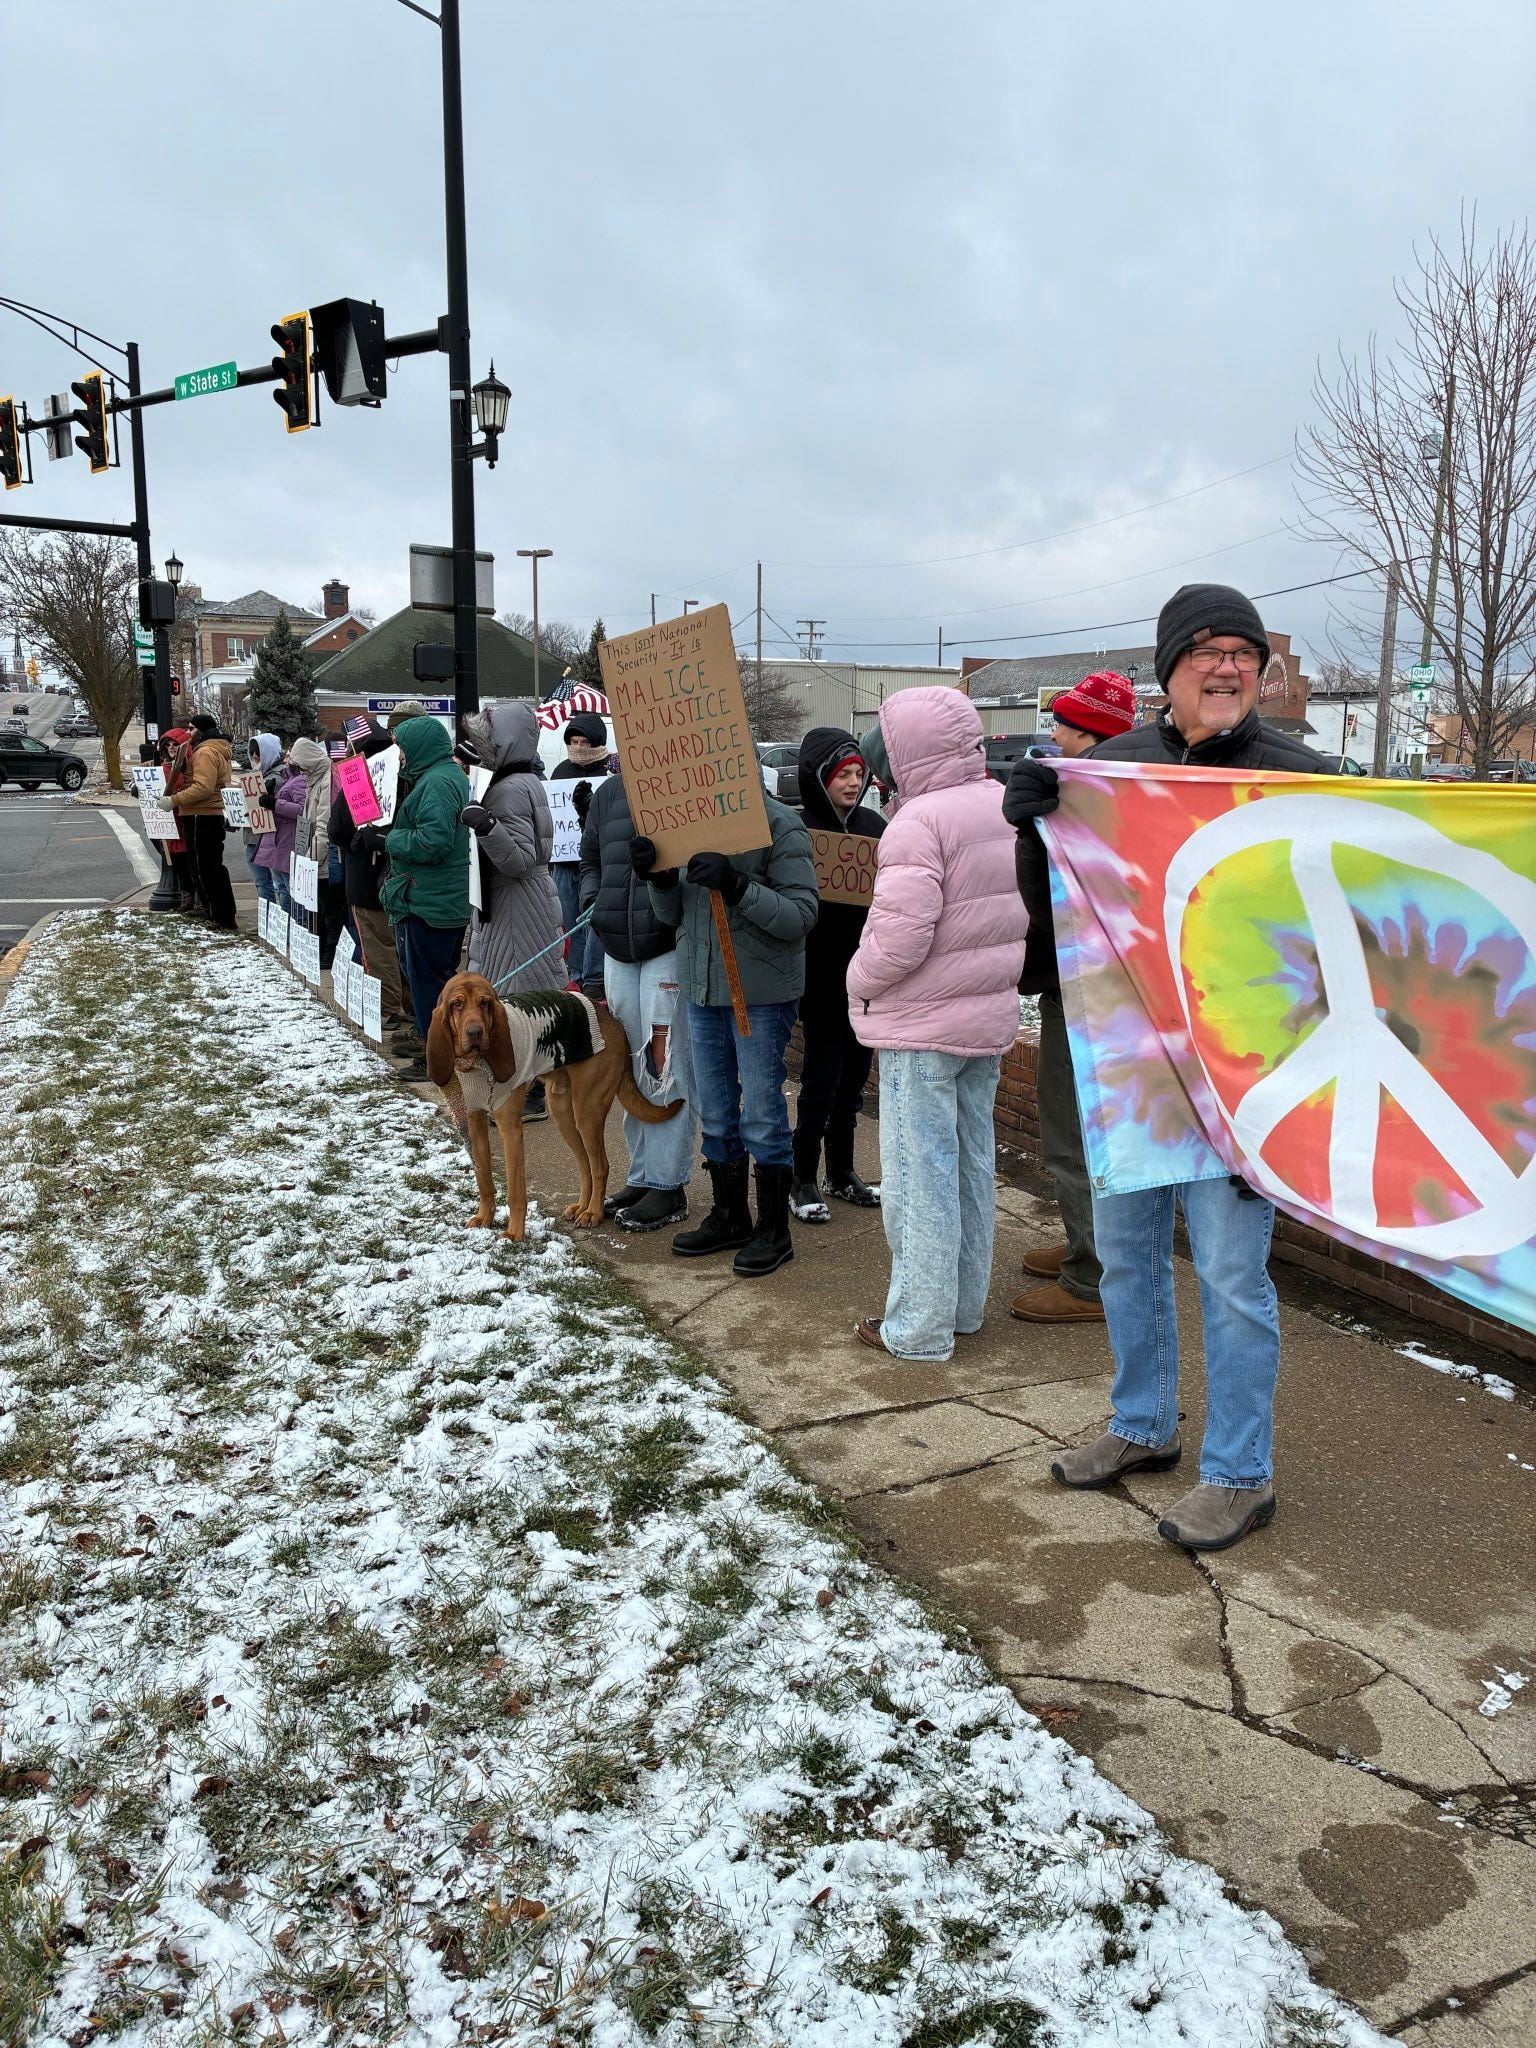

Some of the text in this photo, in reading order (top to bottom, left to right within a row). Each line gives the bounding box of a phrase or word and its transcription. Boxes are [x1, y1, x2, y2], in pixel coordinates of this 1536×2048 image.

[180, 370, 231, 397] W State St
[603, 613, 708, 660] This isn't National
[616, 650, 659, 676] Security
[670, 640, 685, 658] It
[615, 660, 711, 711] MALICE
[376, 701, 395, 710] OLD
[619, 688, 731, 741] INJUSTICE
[628, 723, 742, 773] COWARDICE
[133, 768, 160, 782] ICE
[238, 775, 266, 798] ICE
[636, 754, 748, 804] PREJUDICE
[229, 809, 246, 824] ICE
[251, 808, 273, 829] OUT
[640, 788, 750, 837] DISSERVICE
[814, 862, 872, 894] GOOD
